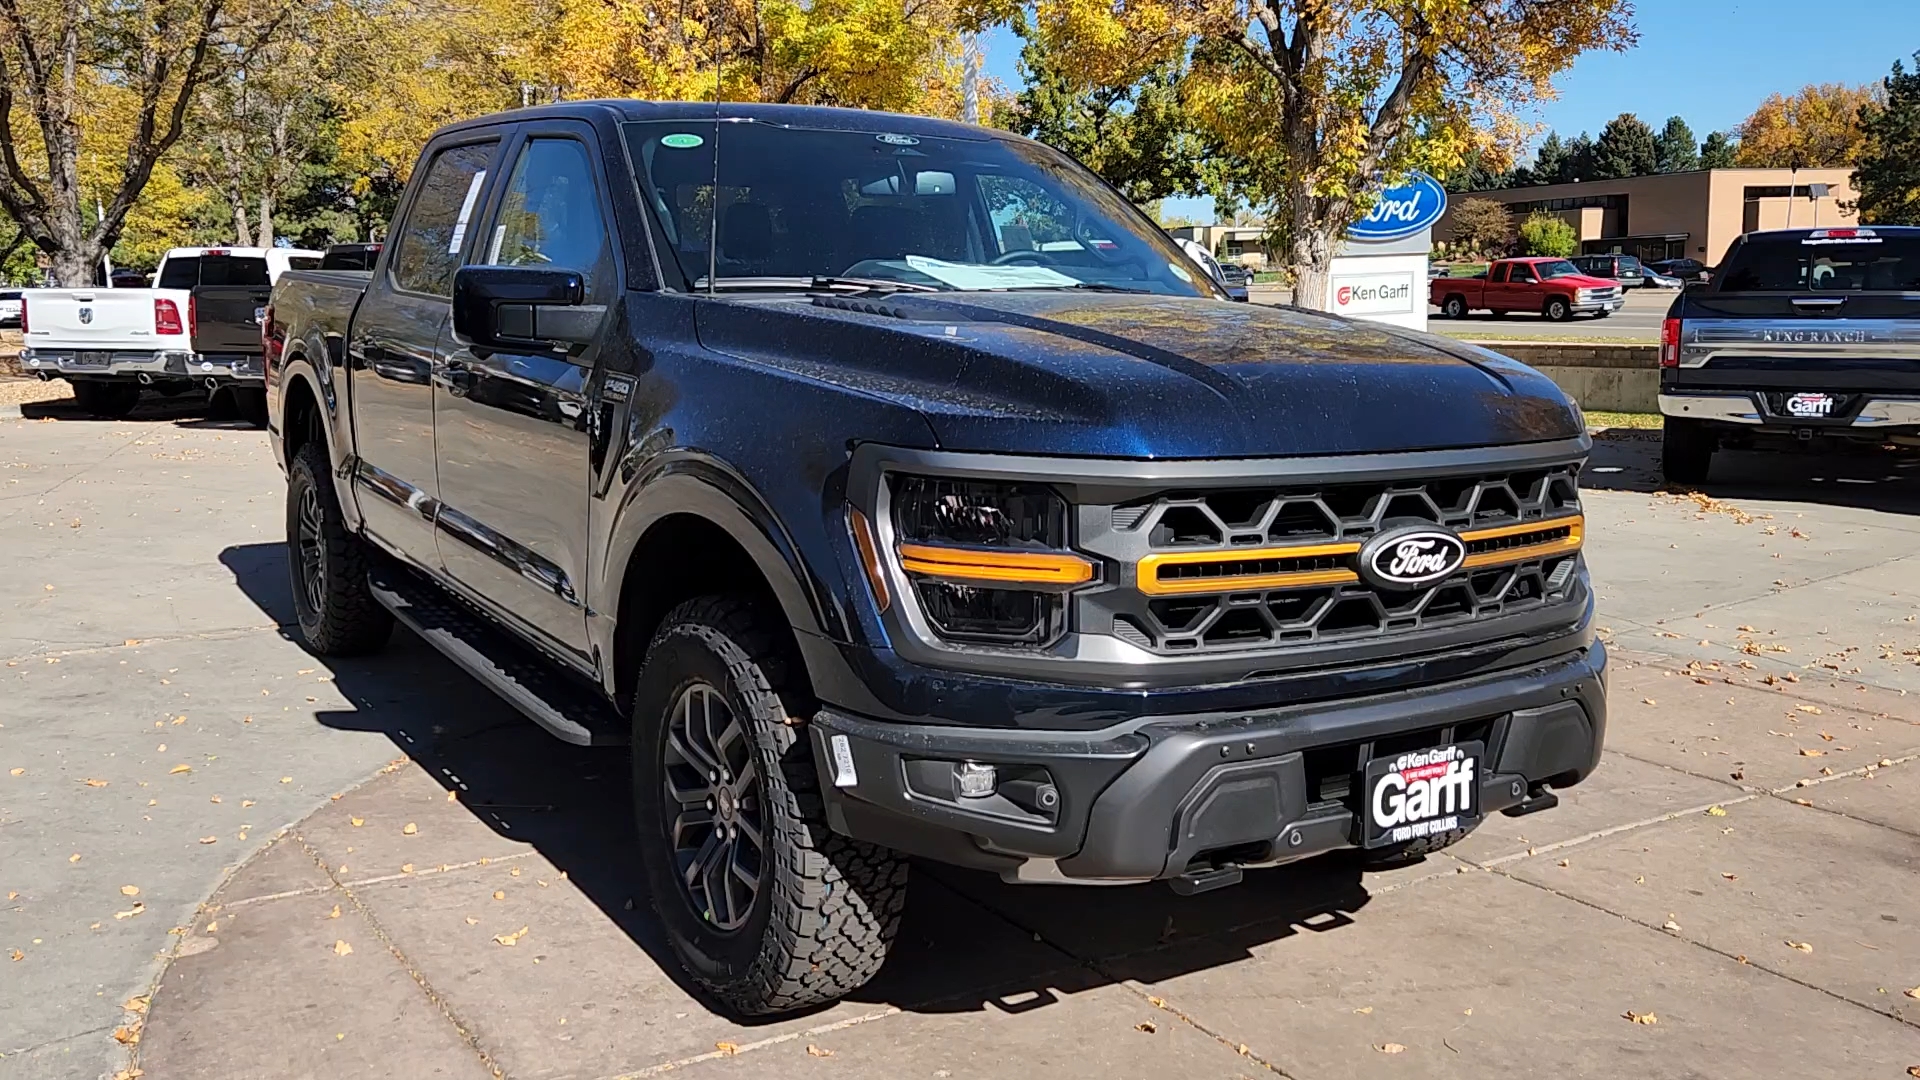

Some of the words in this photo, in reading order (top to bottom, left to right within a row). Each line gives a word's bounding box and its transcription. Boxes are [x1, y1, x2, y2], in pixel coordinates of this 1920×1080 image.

[1366, 185, 1422, 222] ord
[1352, 286, 1376, 300] Ken
[1379, 284, 1409, 299] Garff
[1763, 330, 1804, 342] KING
[1810, 330, 1866, 342] RANCH
[1787, 397, 1833, 413] Garff
[1390, 540, 1449, 575] Ford
[1407, 752, 1428, 768] Ken
[1429, 746, 1456, 764] Garff
[1372, 758, 1474, 828] Garff
[1393, 827, 1411, 841] FORD
[1411, 822, 1429, 838] FORT
[1429, 816, 1458, 834] COLLINS
